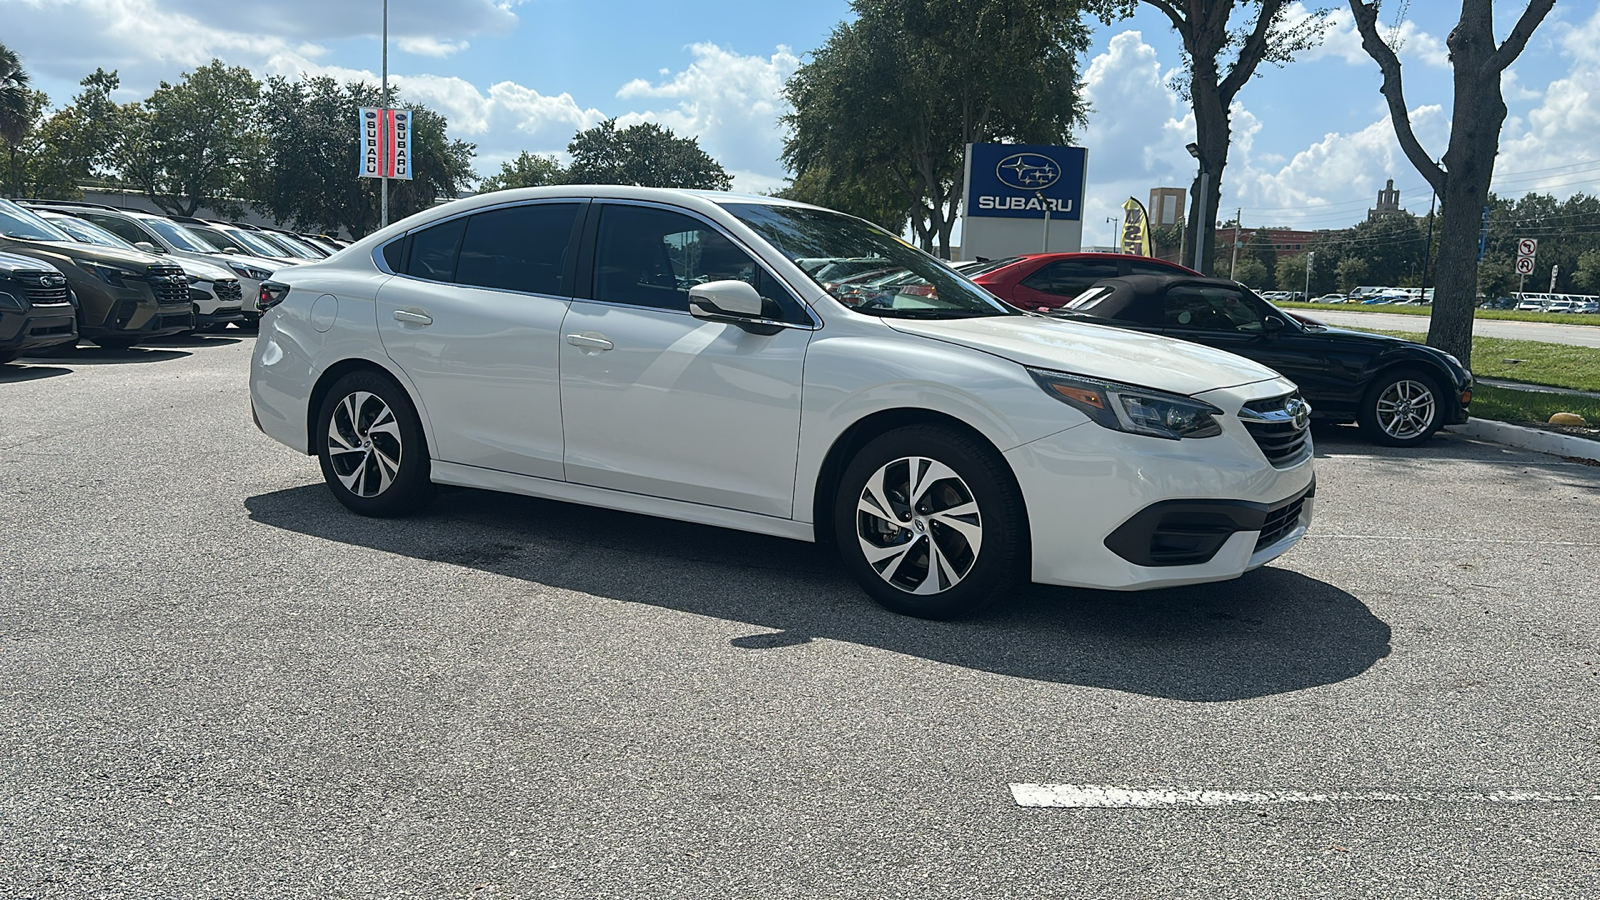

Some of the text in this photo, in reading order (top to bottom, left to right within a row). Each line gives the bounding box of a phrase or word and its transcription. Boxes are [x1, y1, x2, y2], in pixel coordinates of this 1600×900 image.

[367, 121, 376, 173] SUBARU
[397, 123, 406, 174] SUBARU
[978, 195, 1073, 212] SUBARU
